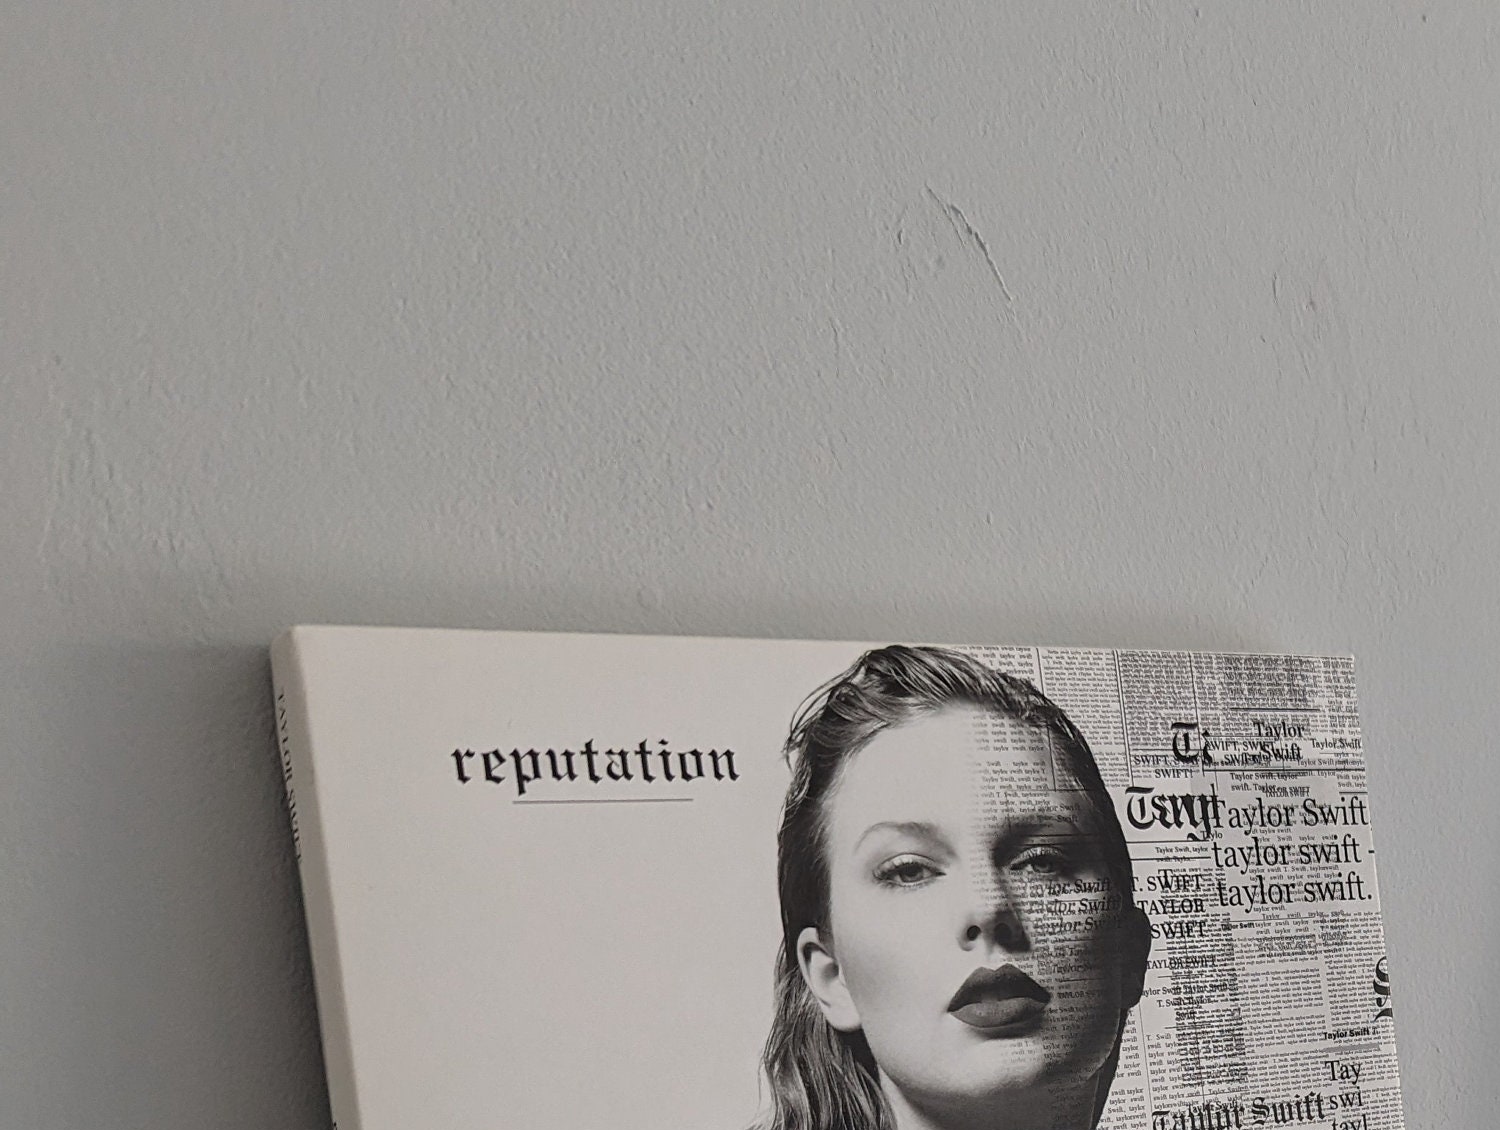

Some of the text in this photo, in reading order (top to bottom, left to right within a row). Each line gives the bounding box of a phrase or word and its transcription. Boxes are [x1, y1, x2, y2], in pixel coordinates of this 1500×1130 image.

[1253, 721, 1305, 741] Taylor
[1261, 743, 1303, 761] Swift
[451, 738, 740, 796] reputation
[1212, 842, 1289, 875] taylor
[1300, 834, 1362, 865] swift
[1147, 874, 1204, 892] SWIFT
[1216, 875, 1296, 913] taylor
[1304, 871, 1372, 902] swift.
[1137, 898, 1206, 915] TAYLOR
[1151, 921, 1206, 939] SWIFT
[1142, 988, 1160, 997] aylor
[1325, 1060, 1362, 1085] Tay
[1251, 1091, 1326, 1124] Swift
[1329, 1086, 1364, 1110] swi
